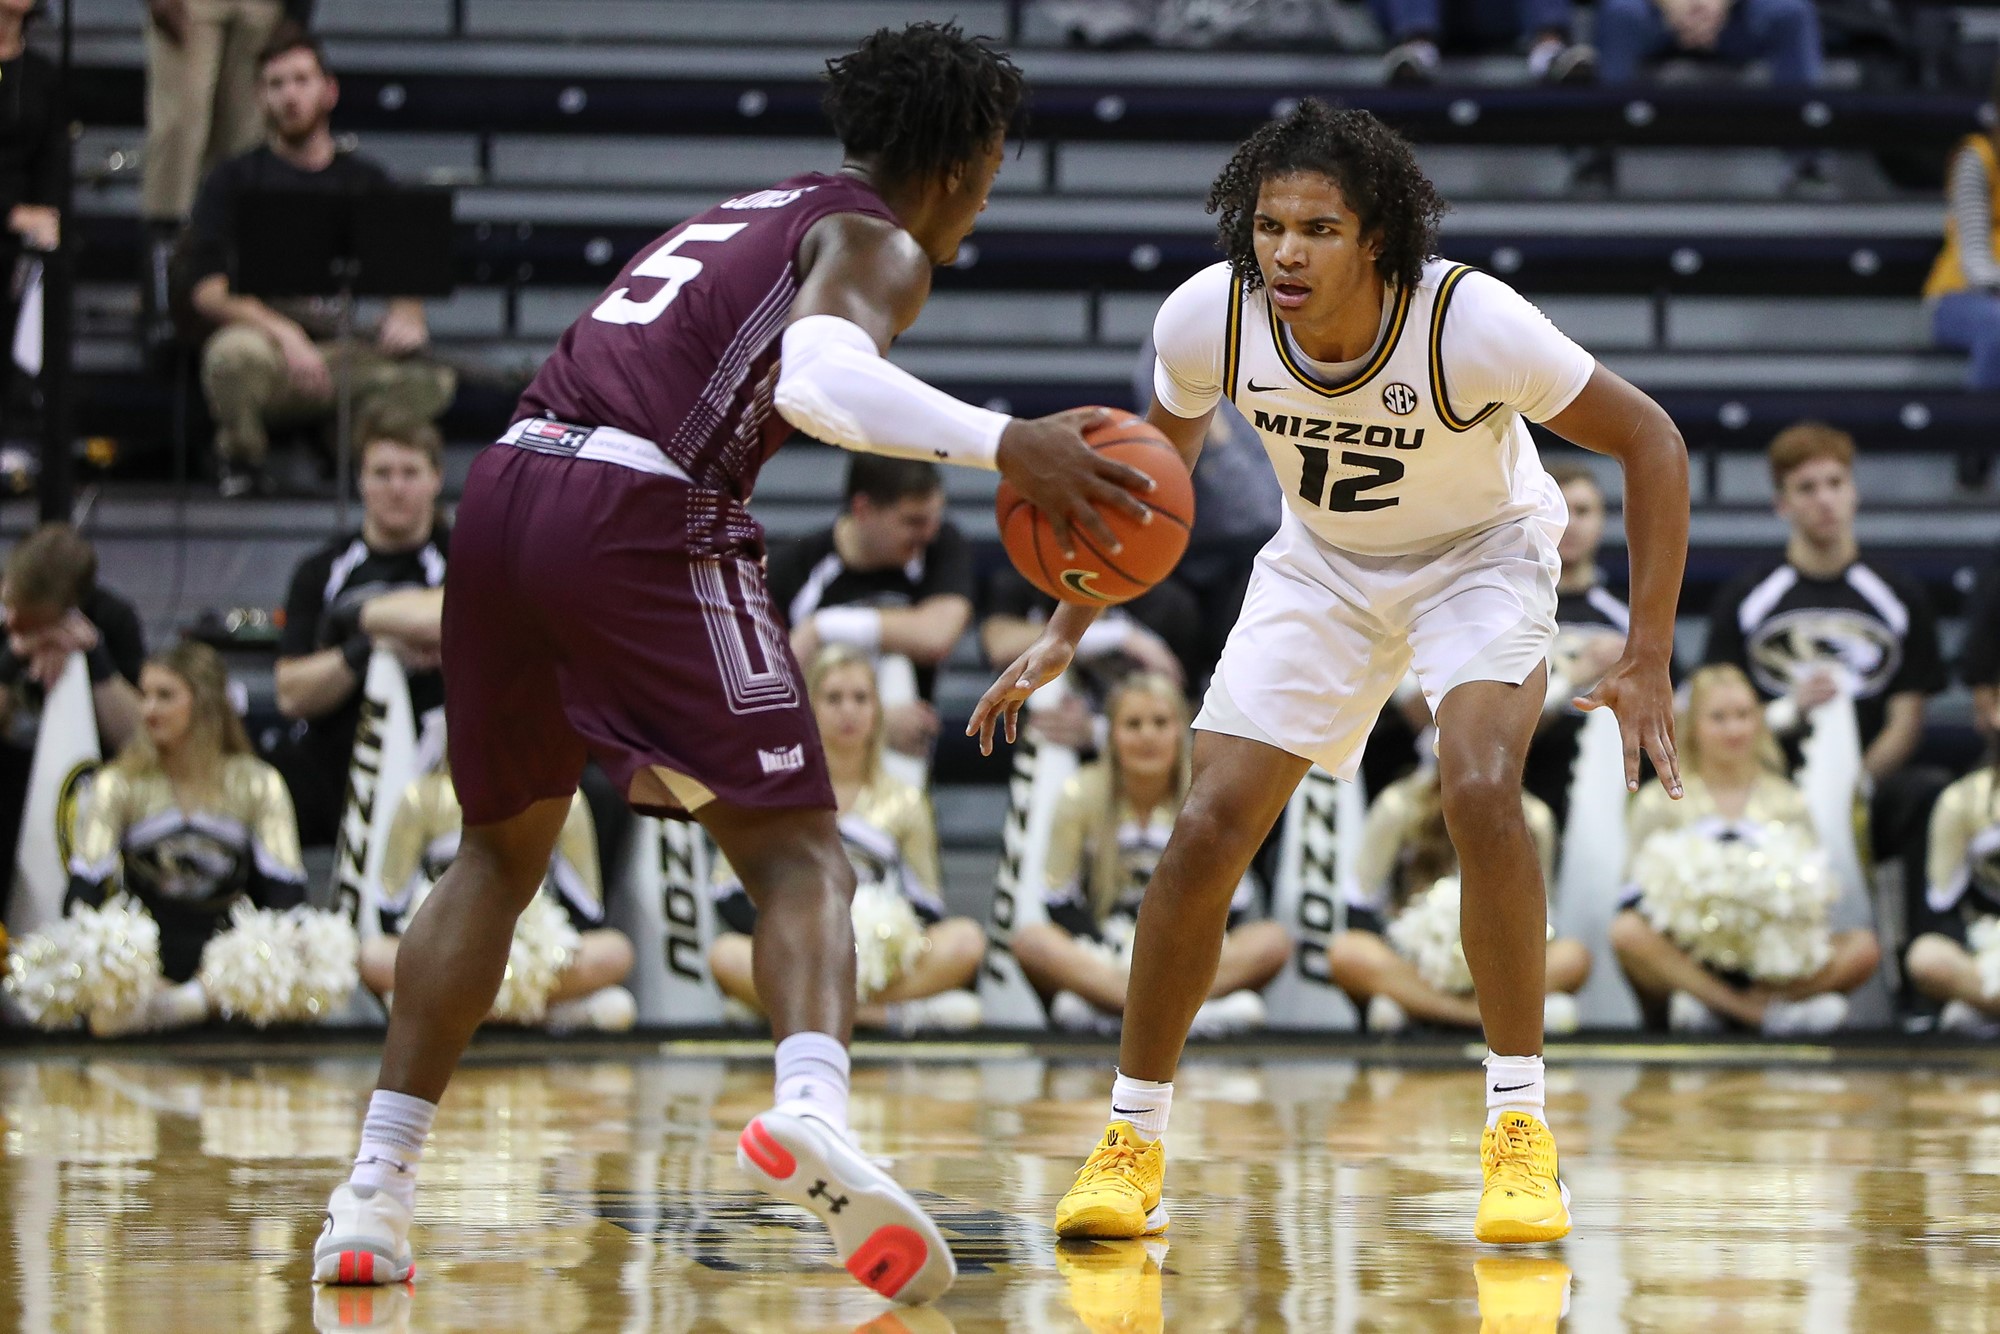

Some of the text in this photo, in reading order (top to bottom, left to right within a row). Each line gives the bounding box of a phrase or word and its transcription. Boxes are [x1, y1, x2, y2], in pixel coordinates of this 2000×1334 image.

[592, 223, 749, 325] 5
[1254, 410, 1425, 450] MIZZOU
[1383, 383, 1417, 415] SEC
[1294, 444, 1405, 513] 12
[757, 742, 805, 773] VALLEY
[338, 698, 388, 926] MIZZO
[659, 816, 703, 982] ZOU
